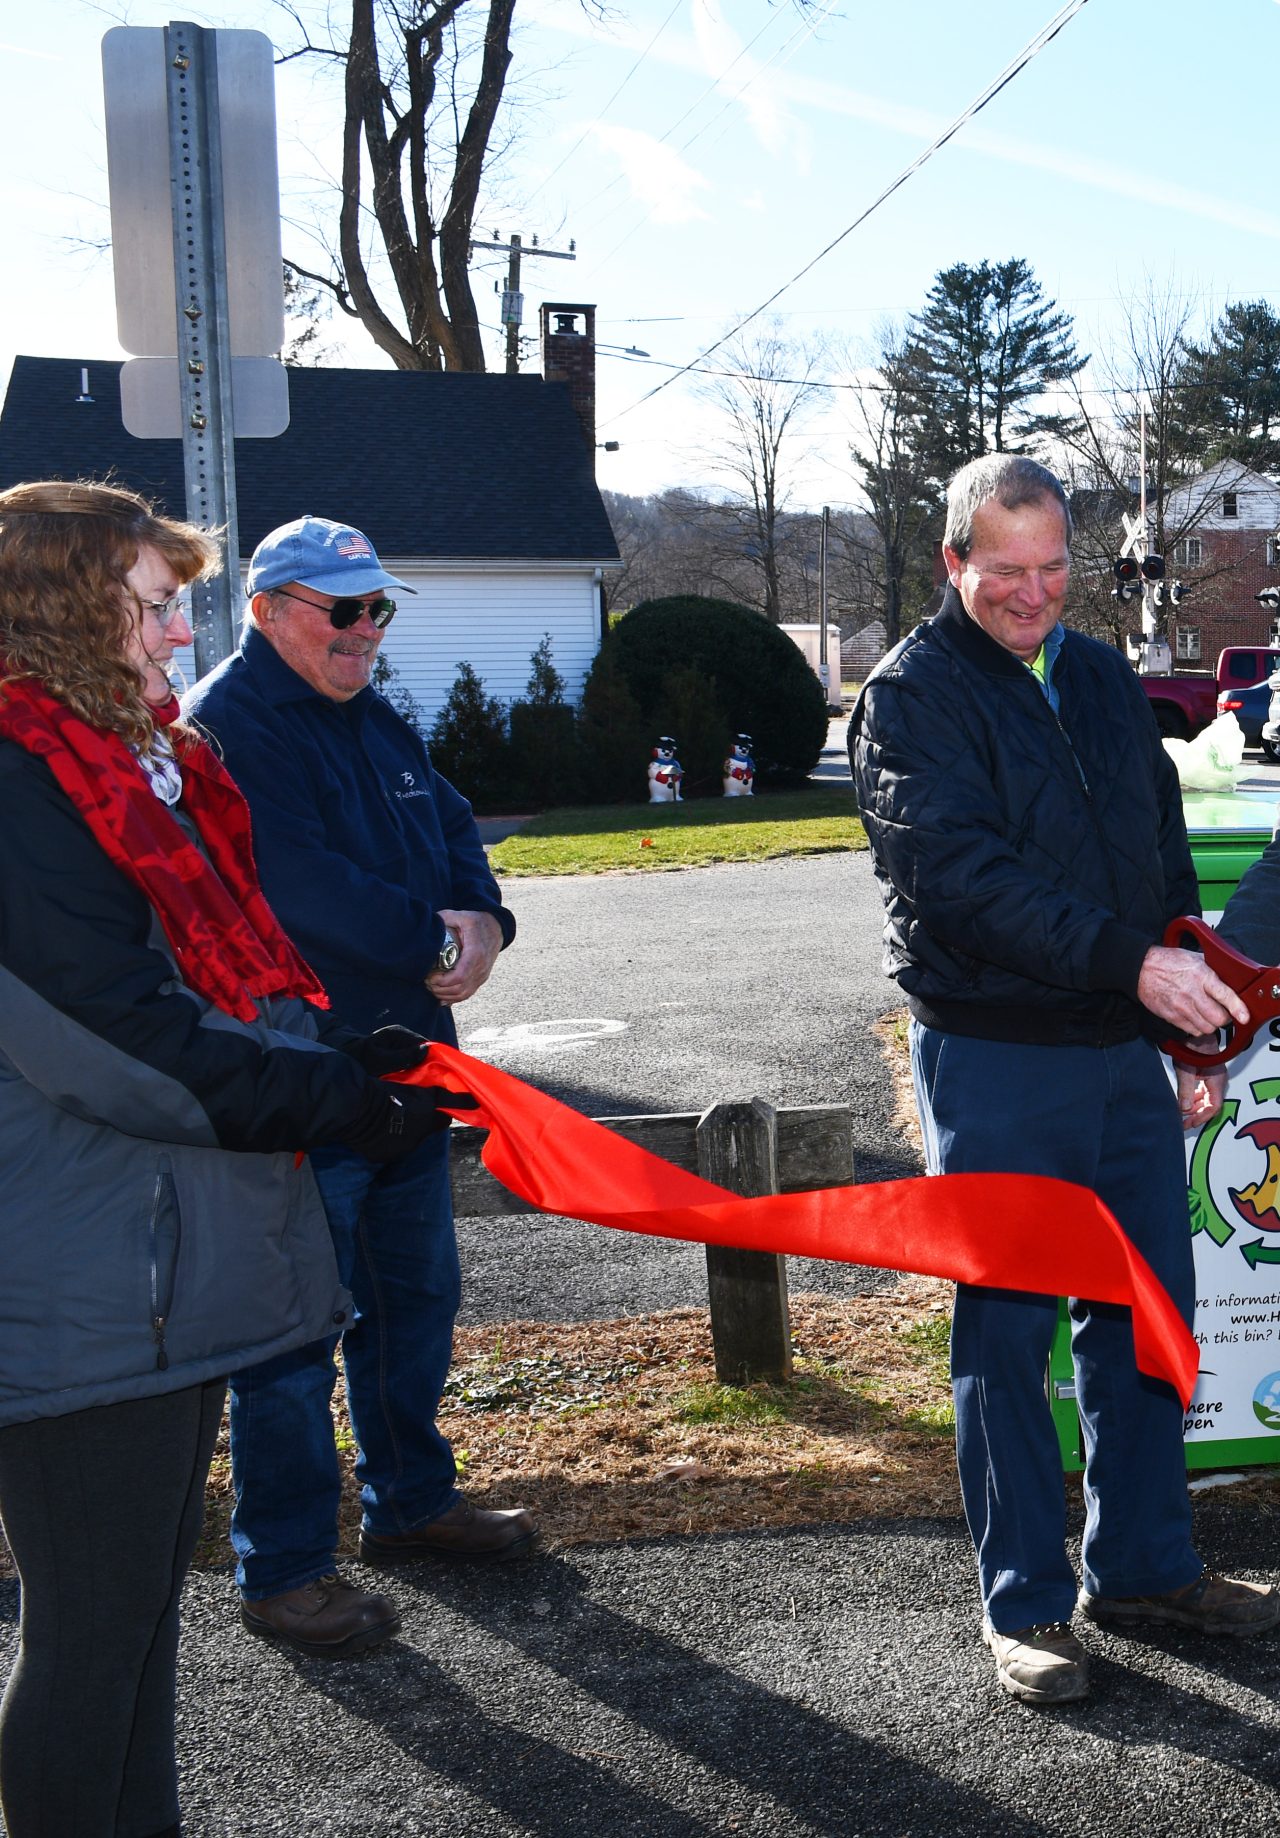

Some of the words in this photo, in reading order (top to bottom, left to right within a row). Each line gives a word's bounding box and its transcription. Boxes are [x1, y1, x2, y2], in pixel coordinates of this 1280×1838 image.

[1195, 1298, 1209, 1309] re
[1193, 1332, 1209, 1345] th
[1213, 1331, 1239, 1344] this
[1244, 1329, 1273, 1342] bin?
[1183, 1418, 1215, 1436] pen
